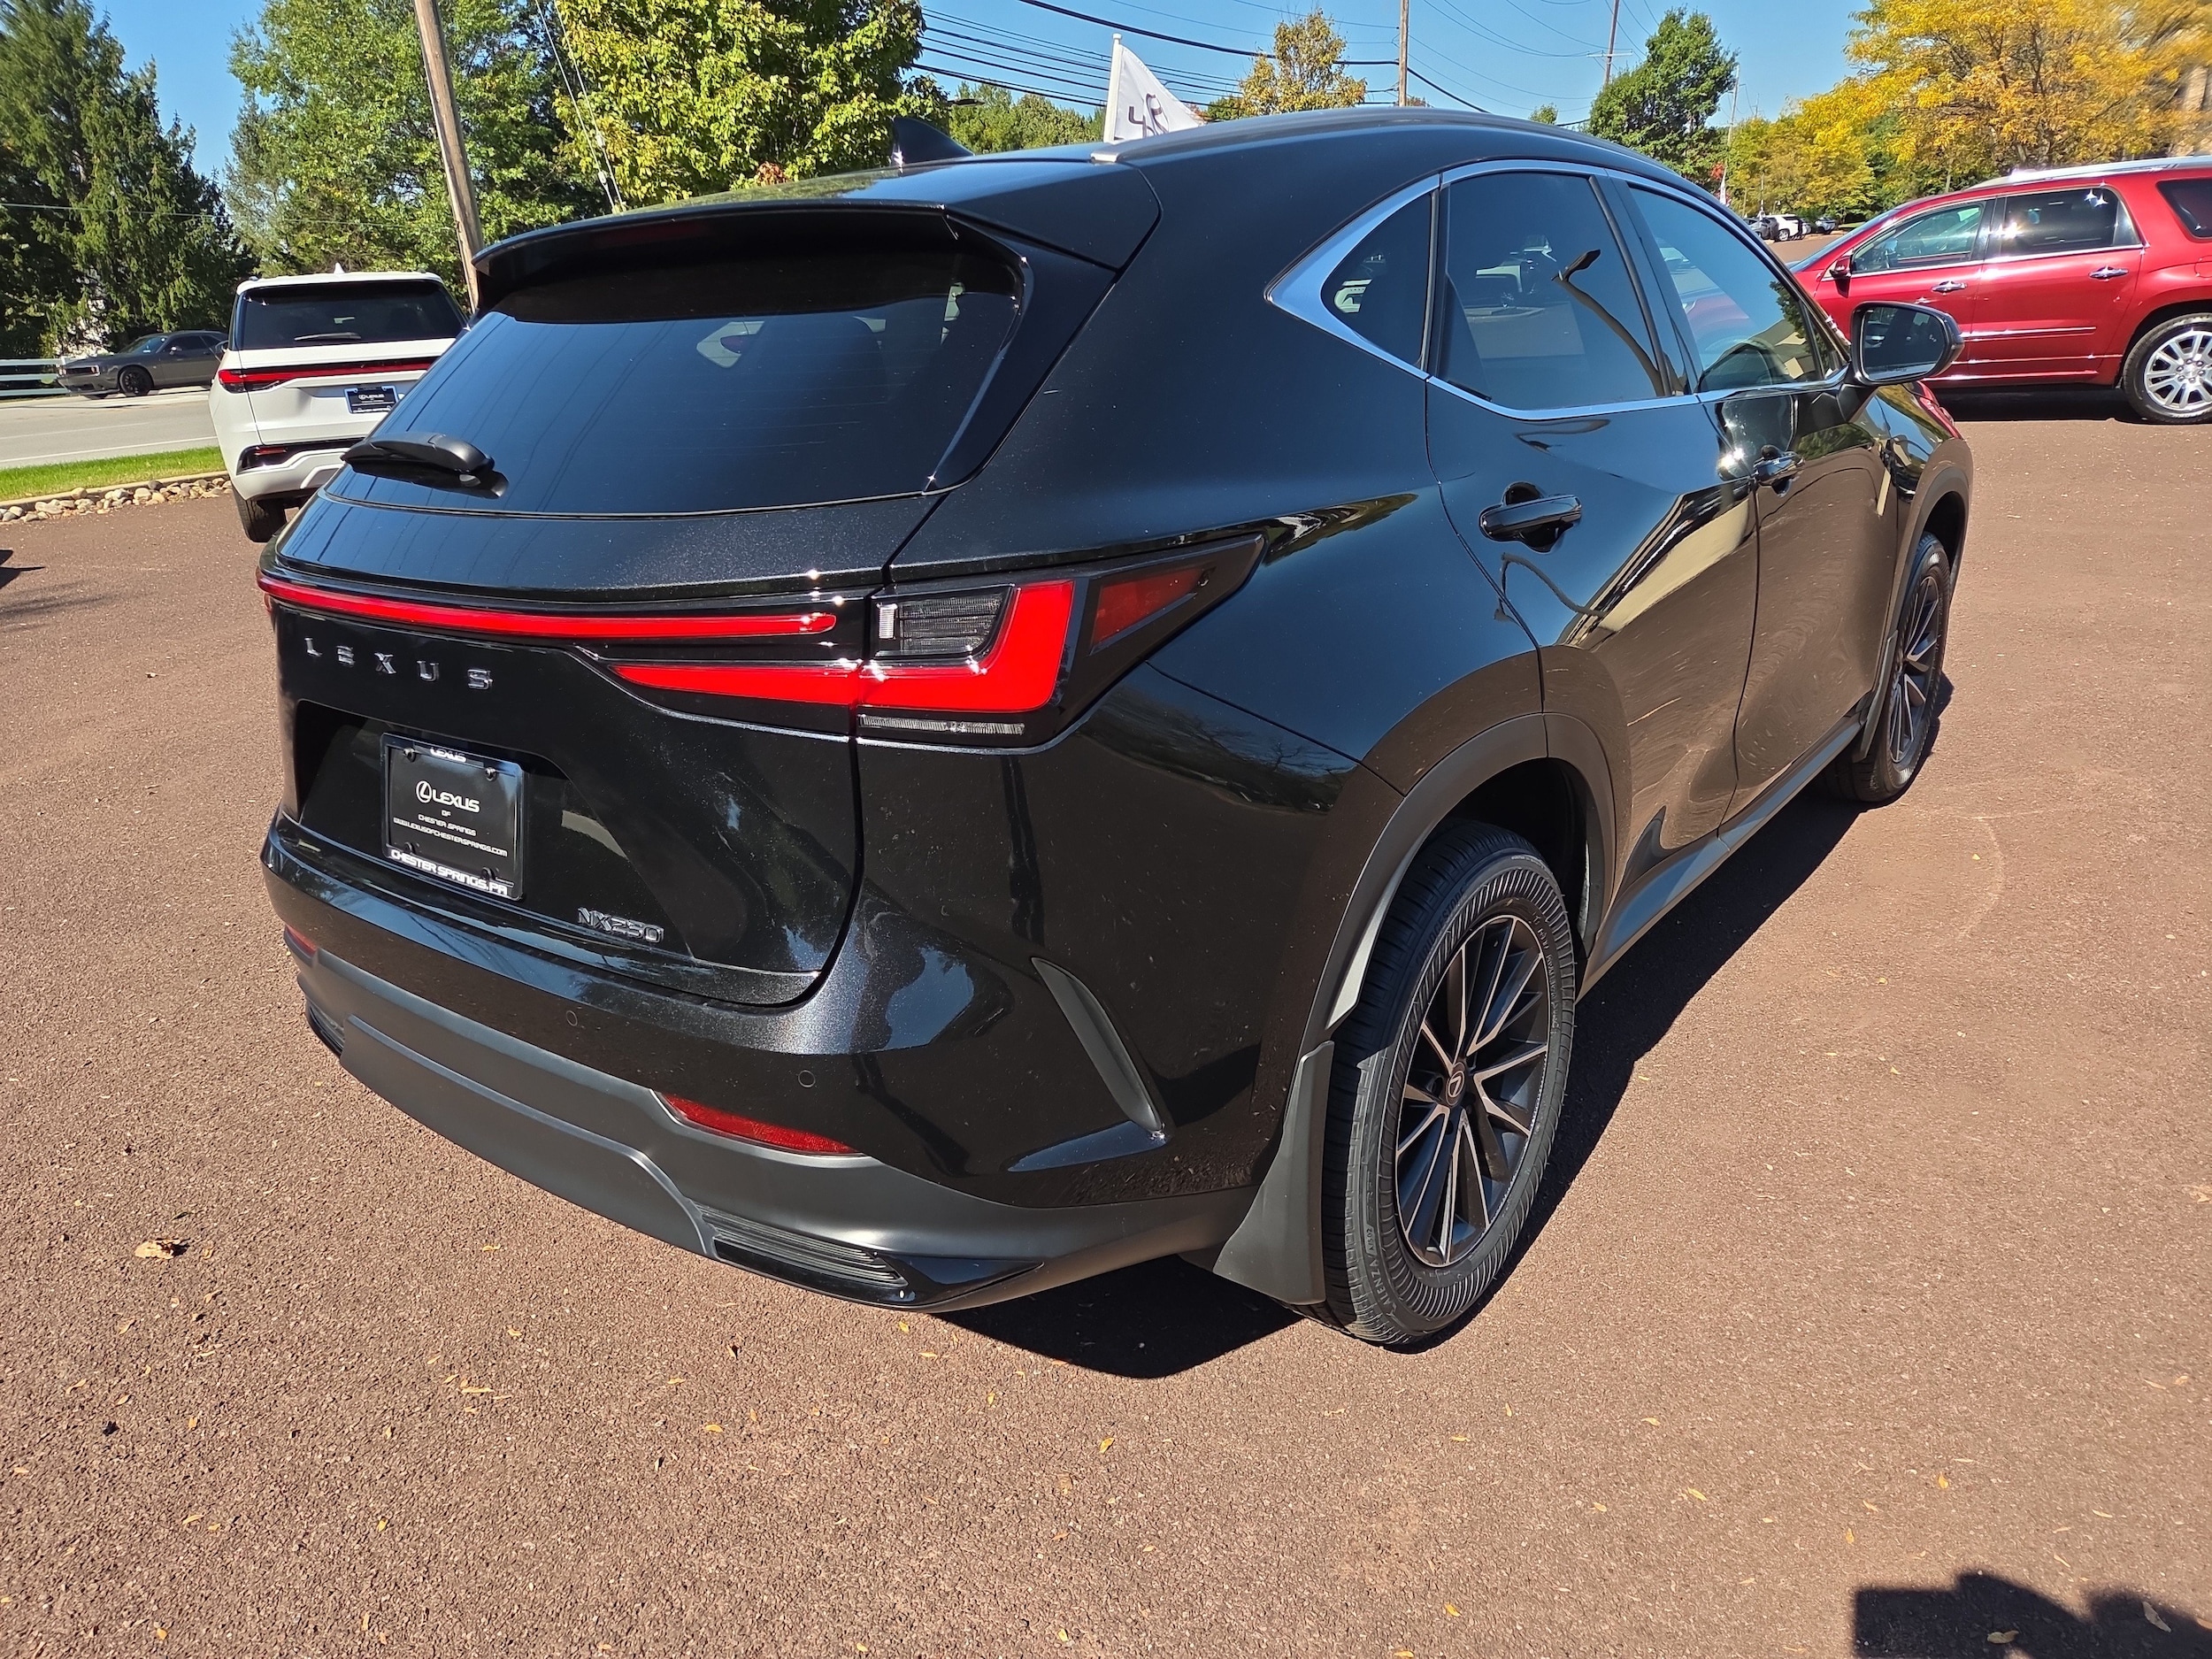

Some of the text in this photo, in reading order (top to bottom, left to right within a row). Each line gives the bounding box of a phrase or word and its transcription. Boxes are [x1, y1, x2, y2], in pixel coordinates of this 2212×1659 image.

[304, 637, 494, 690] LEXUS
[432, 788, 480, 813] LEXUS
[418, 814, 476, 837] CHESTER SPRINGS
[390, 849, 437, 873] CHESTER
[488, 881, 508, 895] PA
[577, 907, 664, 943] NX250
[1370, 1259, 1391, 1305] ALENZA
